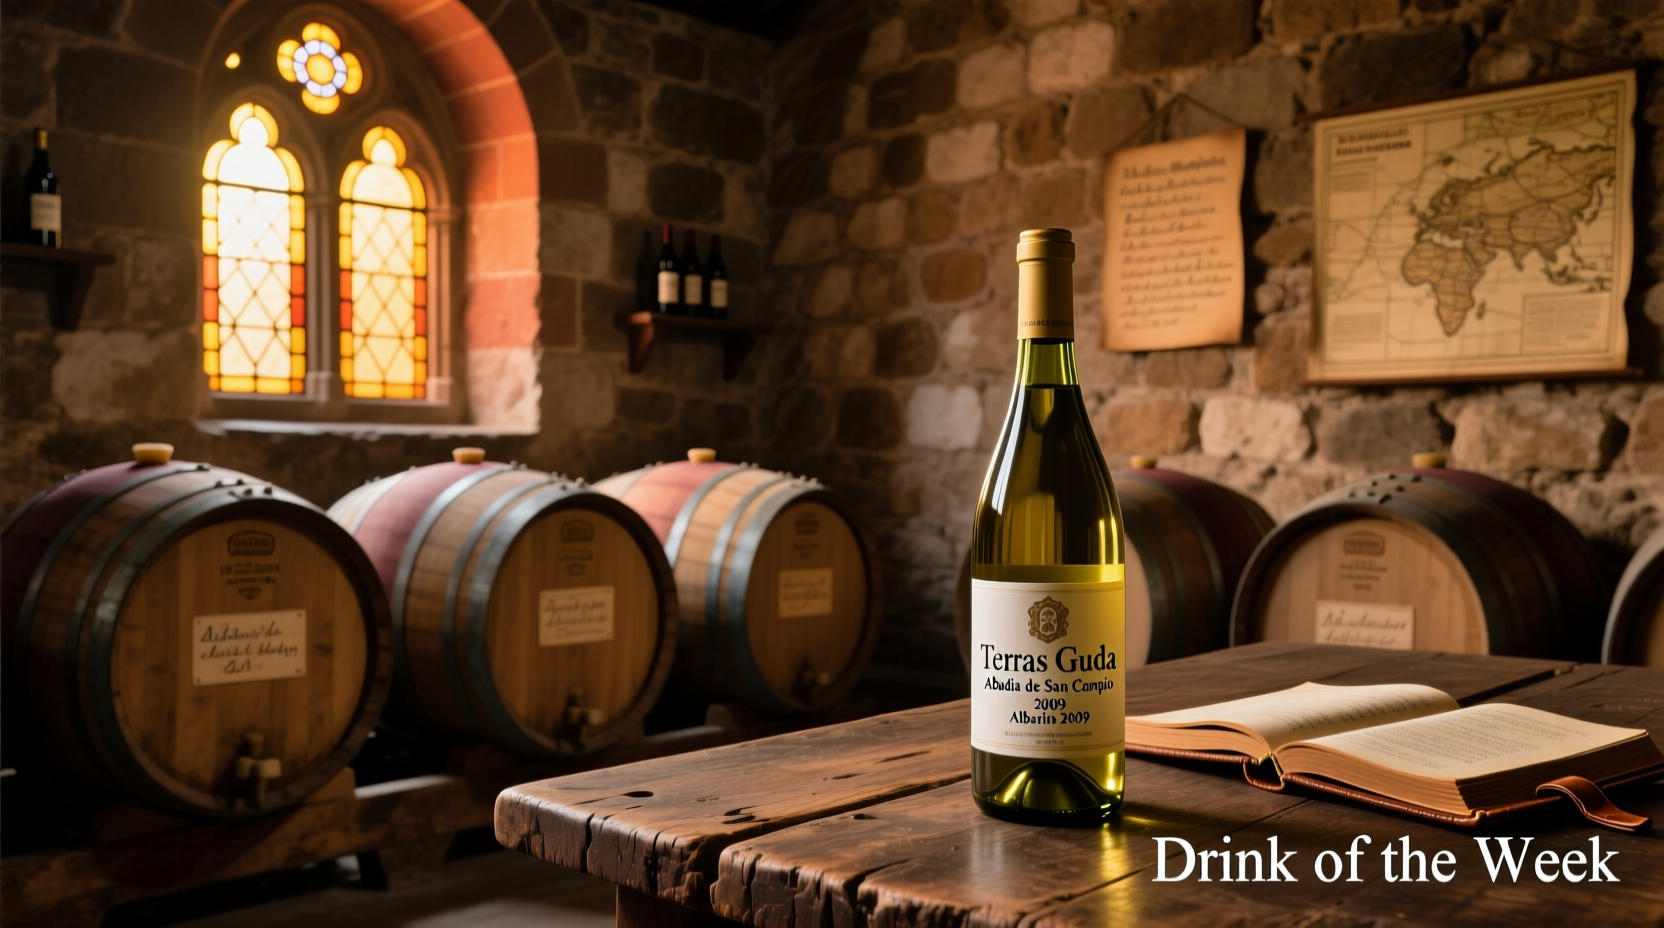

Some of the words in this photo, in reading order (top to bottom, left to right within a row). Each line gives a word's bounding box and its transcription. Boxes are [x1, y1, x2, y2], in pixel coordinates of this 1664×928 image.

[980, 643, 1049, 673] Terras
[1055, 644, 1117, 673] Guda
[1025, 678, 1041, 693] de
[1044, 679, 1069, 693] San
[1034, 698, 1067, 711] 2009
[1059, 711, 1091, 725] 2009
